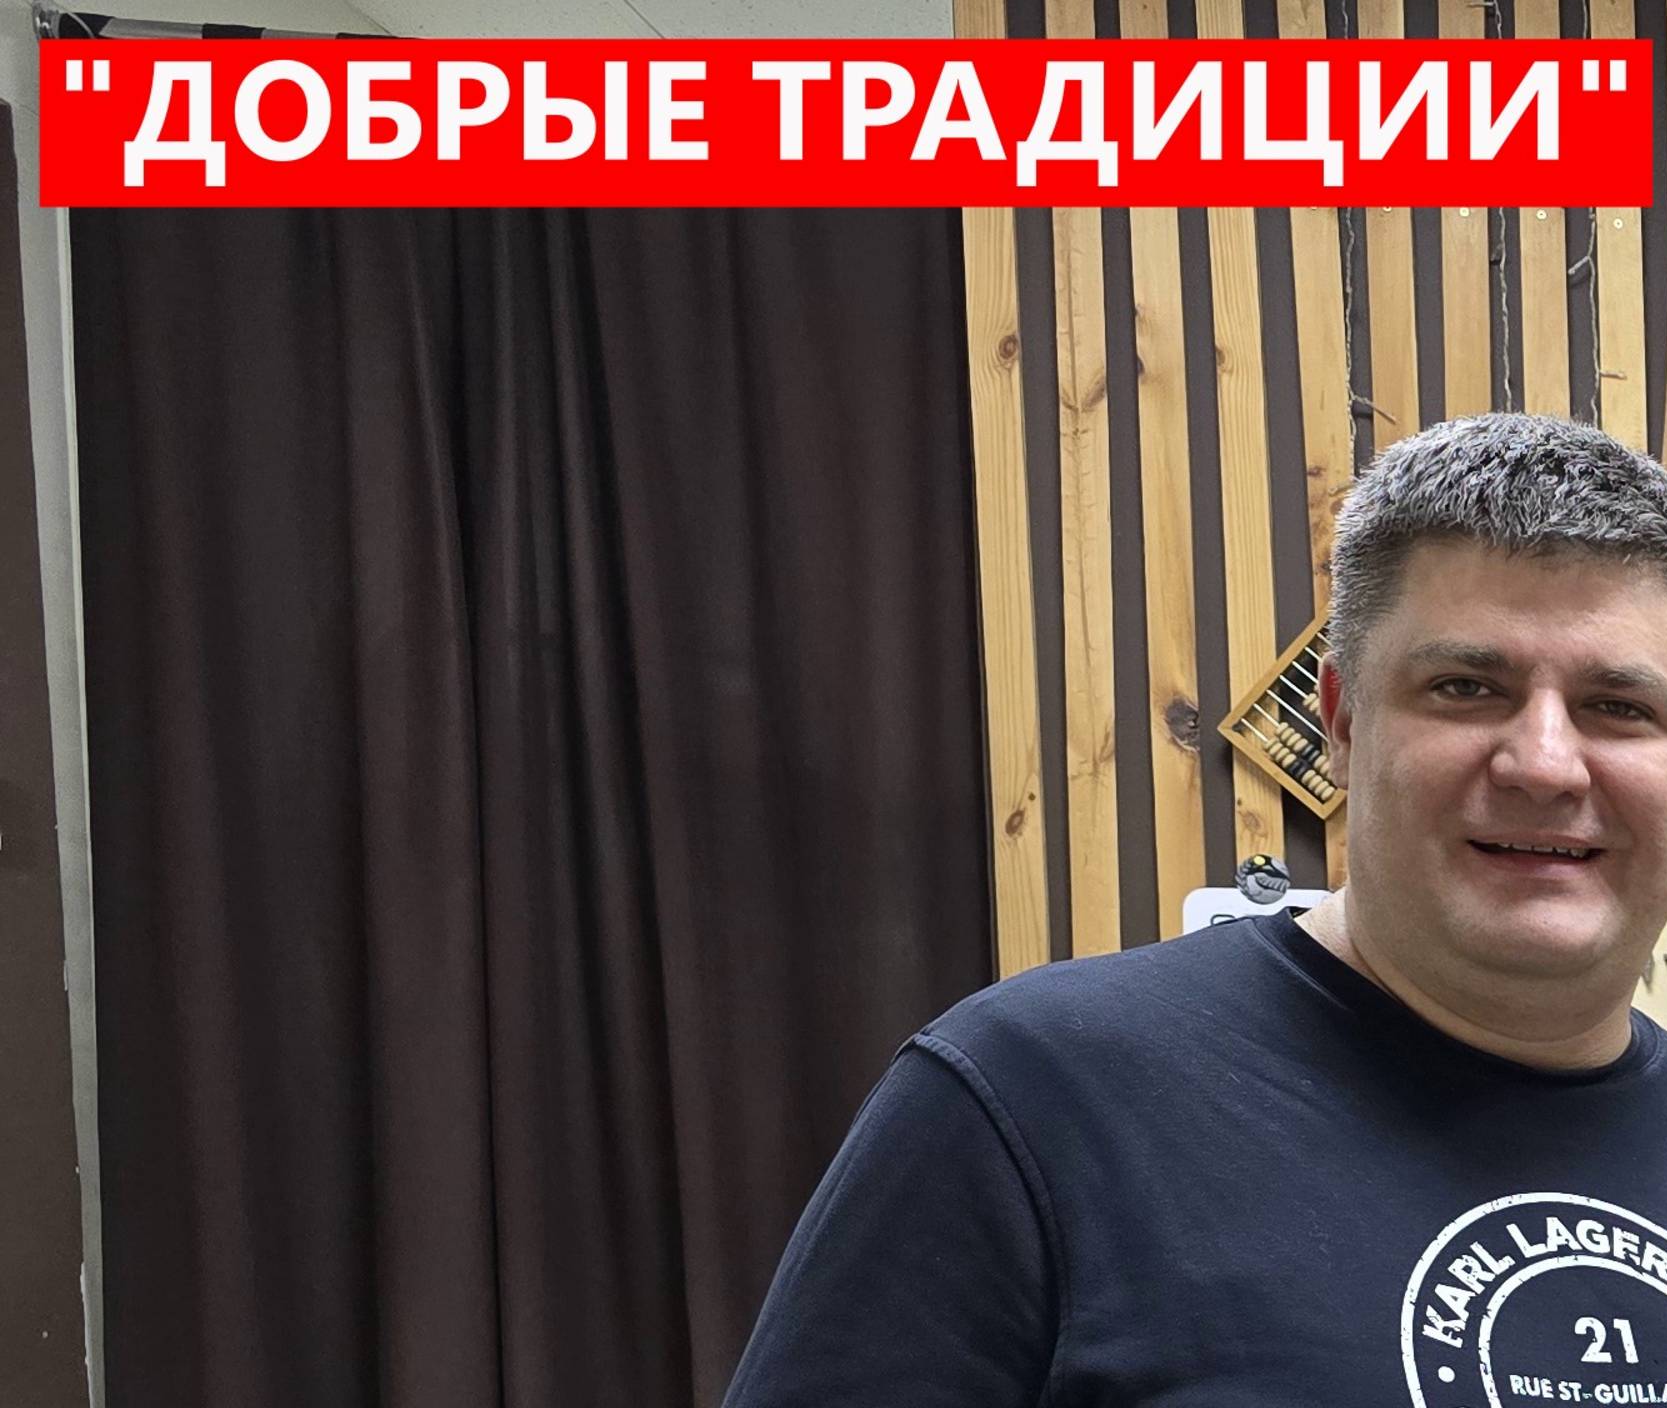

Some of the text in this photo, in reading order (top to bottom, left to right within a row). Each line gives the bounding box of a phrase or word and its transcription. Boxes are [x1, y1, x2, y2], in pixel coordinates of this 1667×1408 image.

[1422, 1241, 1513, 1349] KARL
[1574, 1317, 1640, 1365] 21
[1510, 1374, 1555, 1400] RUE
